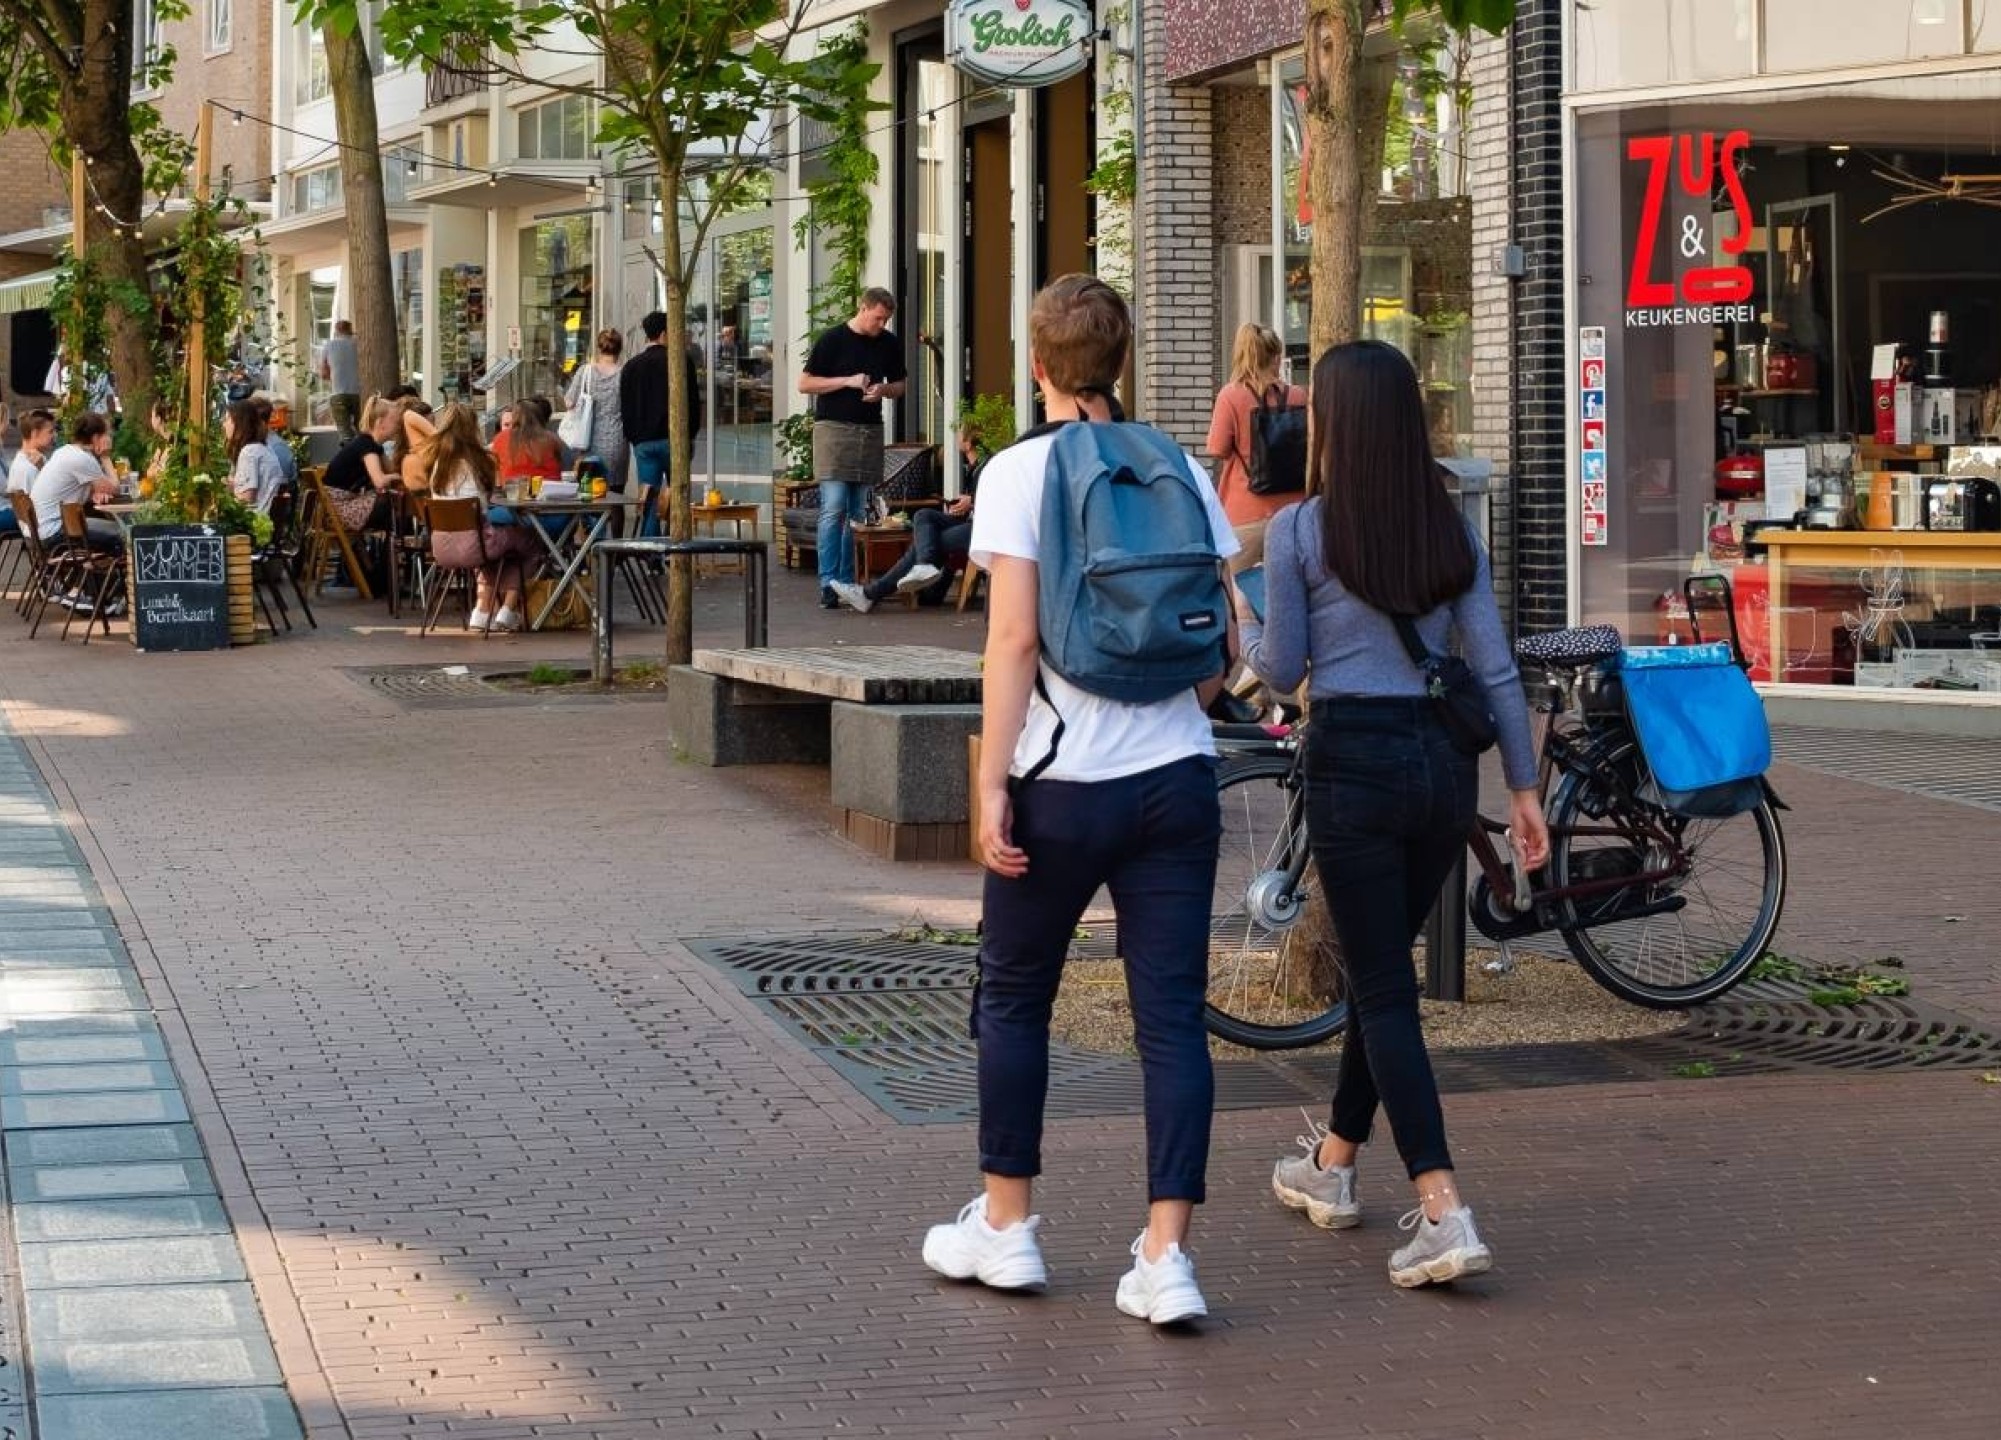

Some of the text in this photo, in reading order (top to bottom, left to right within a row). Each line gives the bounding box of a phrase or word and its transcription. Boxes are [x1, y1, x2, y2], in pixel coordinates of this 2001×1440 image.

[970, 9, 1074, 53] Grolsch
[1626, 305, 1754, 328] KEUKENGEREI
[138, 541, 222, 562] WUNDER
[141, 560, 222, 580] KAMMER
